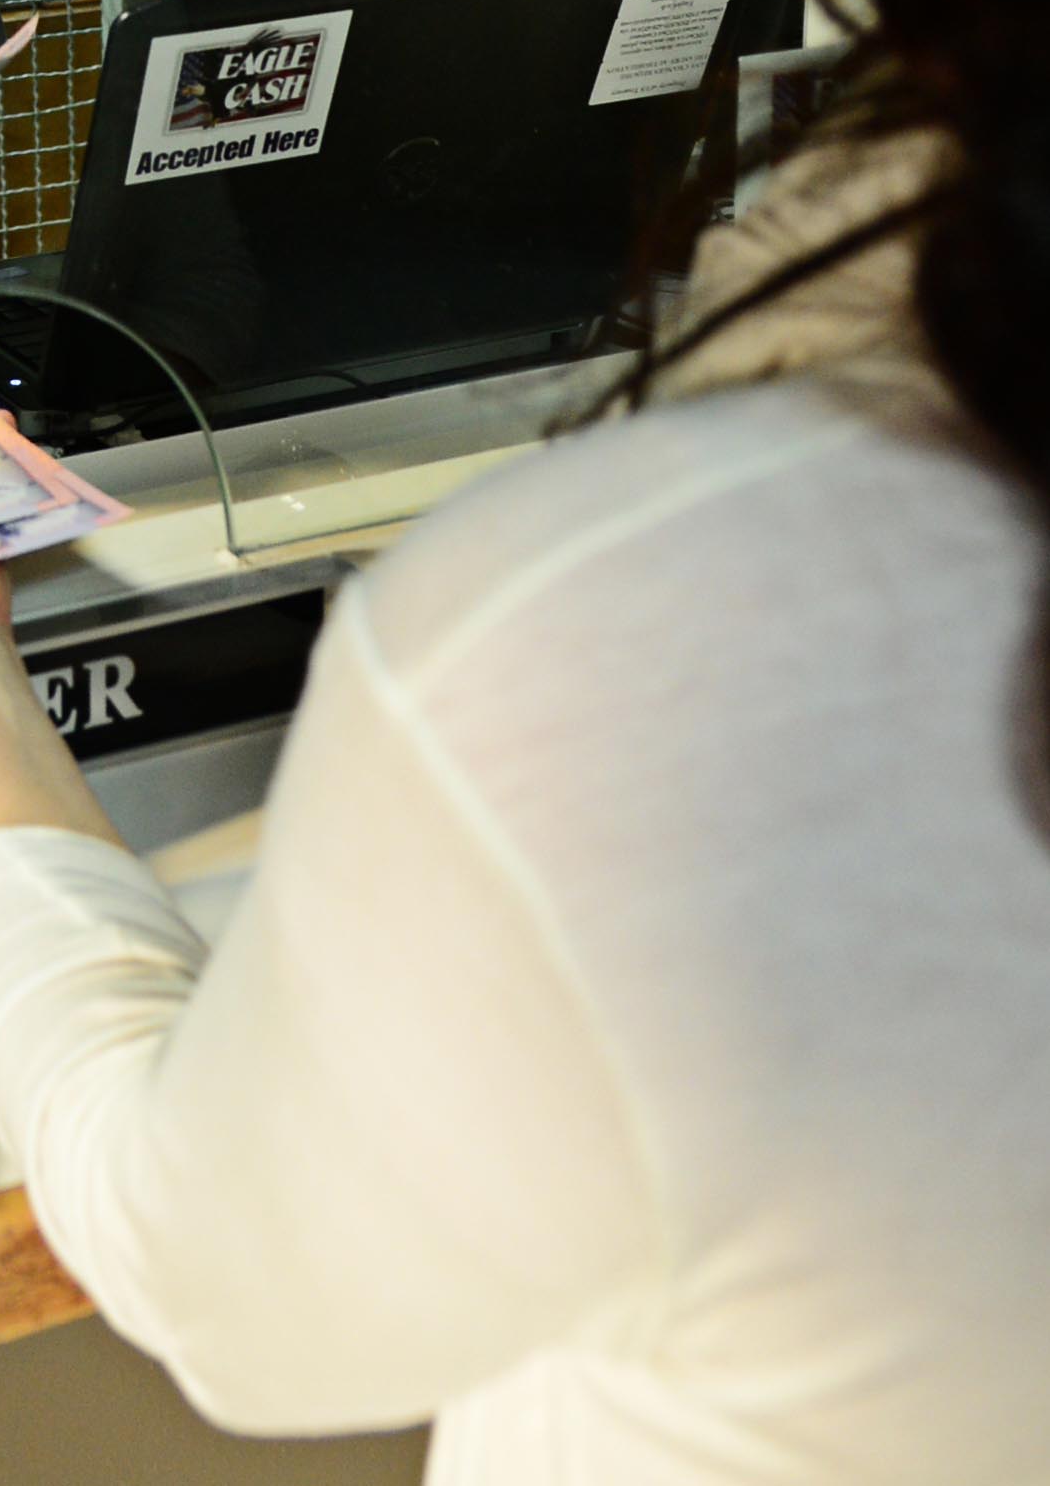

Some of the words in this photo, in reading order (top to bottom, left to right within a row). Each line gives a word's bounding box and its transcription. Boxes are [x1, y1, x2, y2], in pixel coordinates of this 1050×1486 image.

[217, 41, 315, 80] EAGLE
[223, 73, 308, 110] CASH
[135, 134, 257, 176] Accepted
[261, 127, 320, 156] Here
